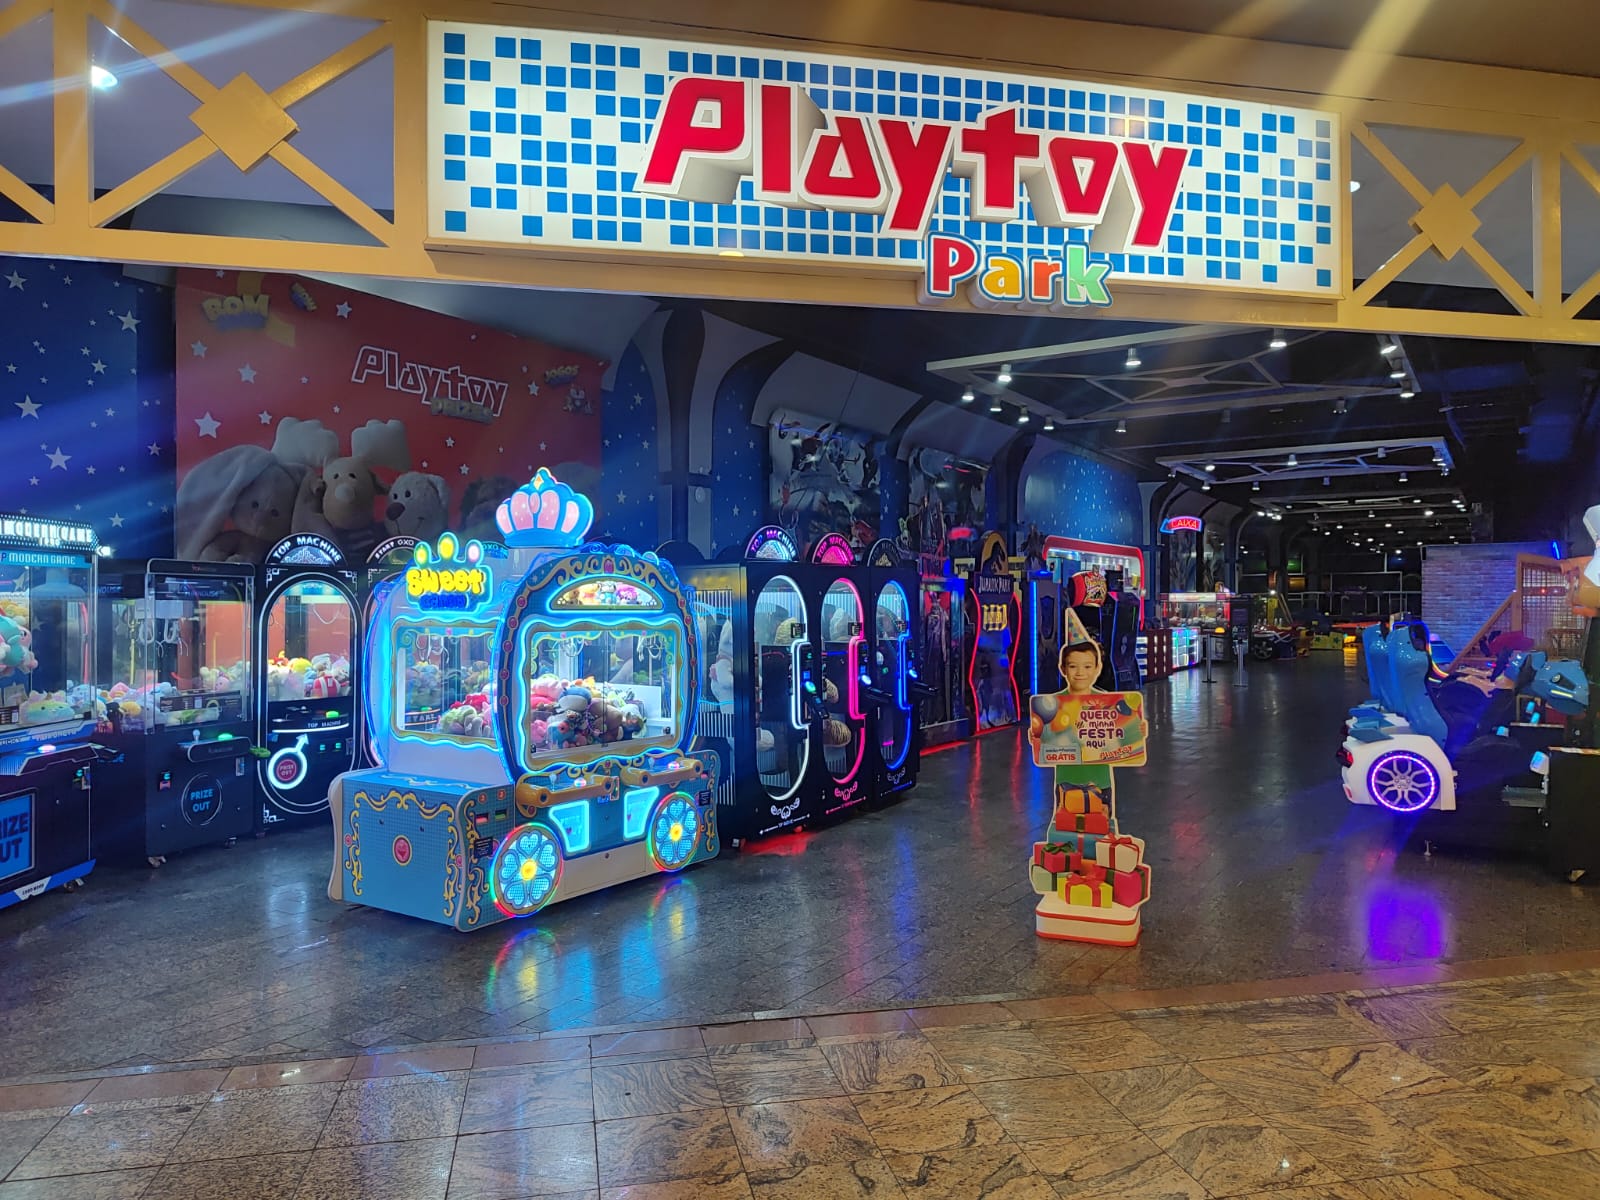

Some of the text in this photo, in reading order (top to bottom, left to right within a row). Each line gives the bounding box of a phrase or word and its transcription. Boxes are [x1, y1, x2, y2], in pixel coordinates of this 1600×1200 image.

[636, 76, 1189, 252] Playtoy
[926, 231, 1113, 308] Park
[352, 346, 508, 416] Playtoy
[1170, 519, 1197, 529] CAIXA
[272, 535, 342, 564] TOP MACHINE
[9, 553, 49, 564] MODERN
[50, 555, 76, 565] GAME
[1080, 711, 1118, 722] QUERO
[1079, 729, 1124, 739] FESTA
[190, 789, 213, 801] PRIZE
[192, 801, 210, 812] OUT
